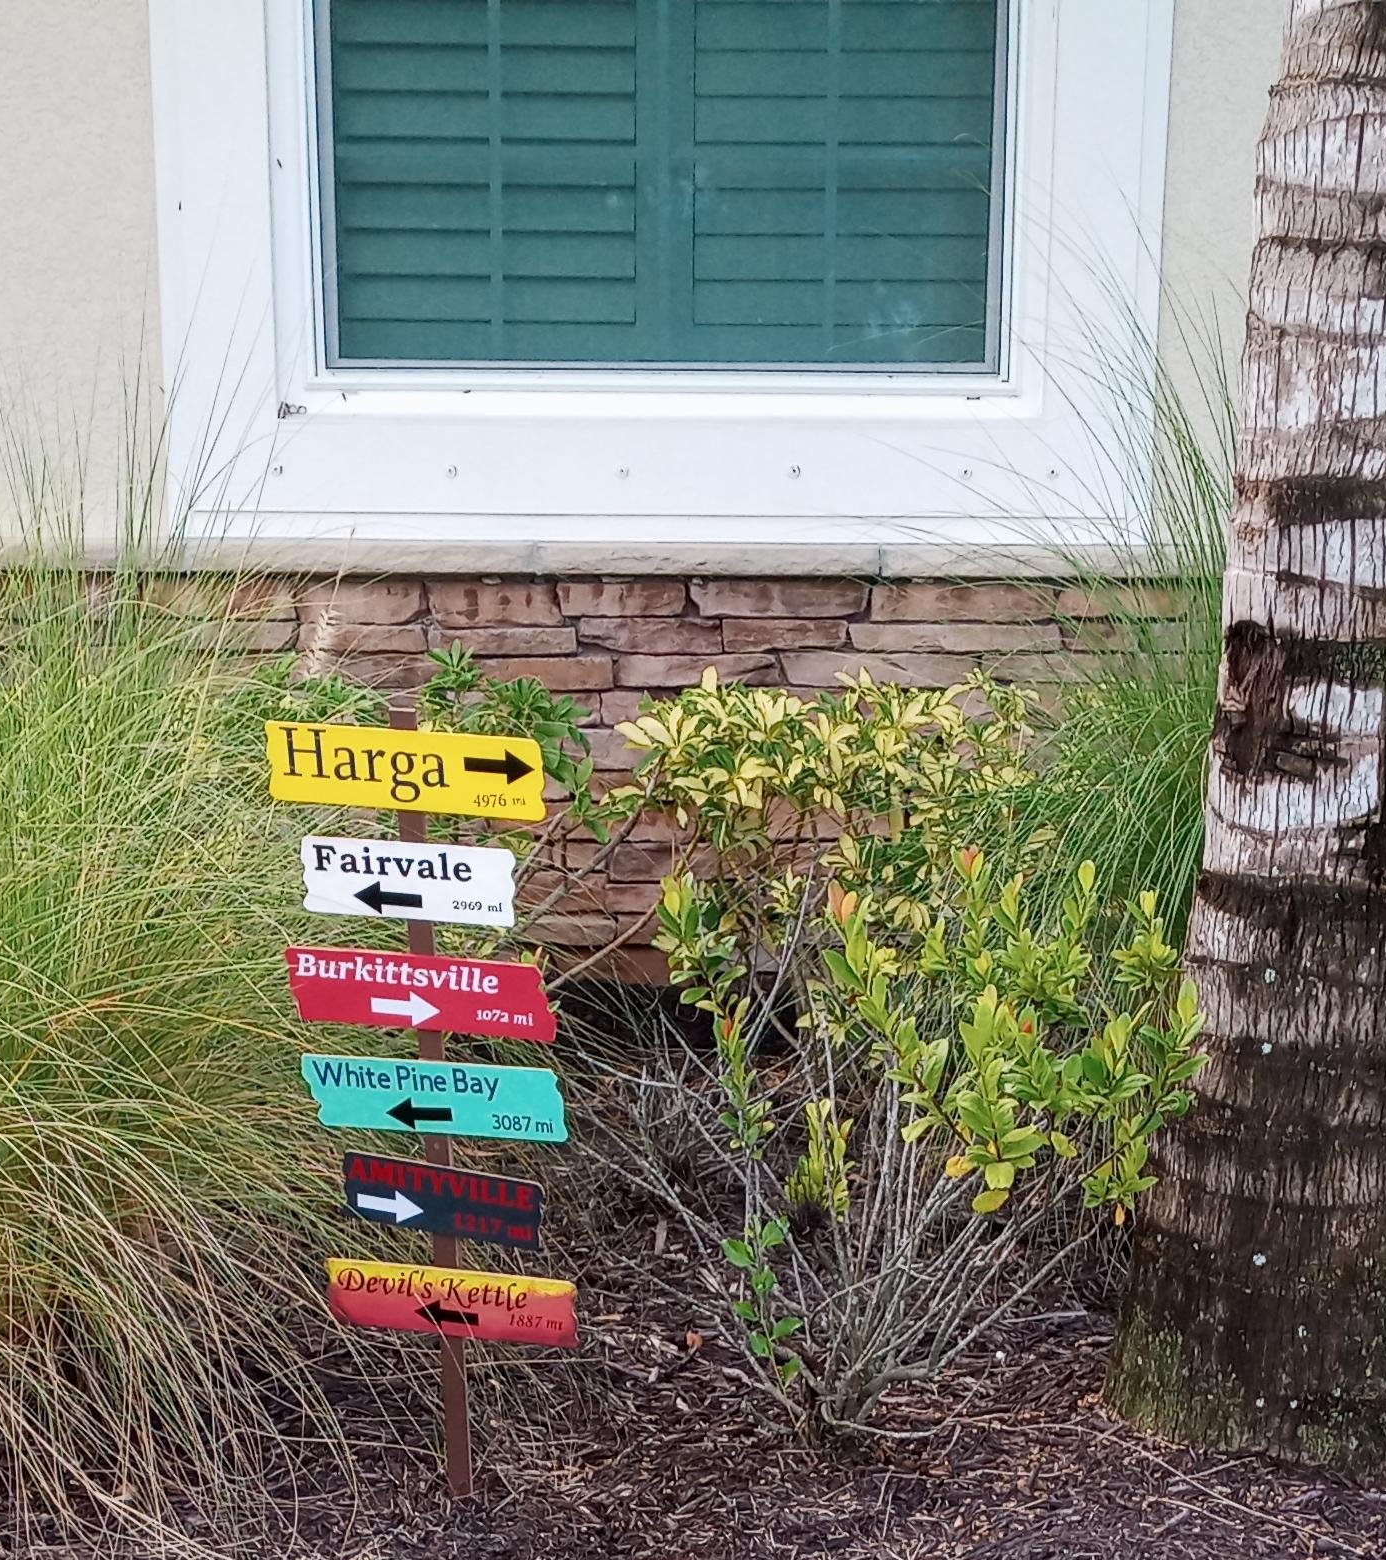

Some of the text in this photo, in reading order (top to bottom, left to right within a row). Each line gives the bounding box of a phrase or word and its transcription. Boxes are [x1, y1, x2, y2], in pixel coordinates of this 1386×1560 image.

[279, 727, 449, 802] Harga
[473, 794, 507, 807] 4976
[313, 844, 472, 882] Fairvale
[452, 900, 502, 912] 2969 mi
[296, 953, 499, 994] Burkittsville
[476, 1009, 534, 1027] 1072 mi
[313, 1060, 499, 1102] White Pine Bay
[492, 1115, 554, 1134] 3087 mi
[347, 1155, 535, 1212] AMITYVILLE
[454, 1213, 502, 1233] 1217
[337, 1267, 528, 1312] Devil's Kettle
[509, 1313, 563, 1331] 1887 mi
